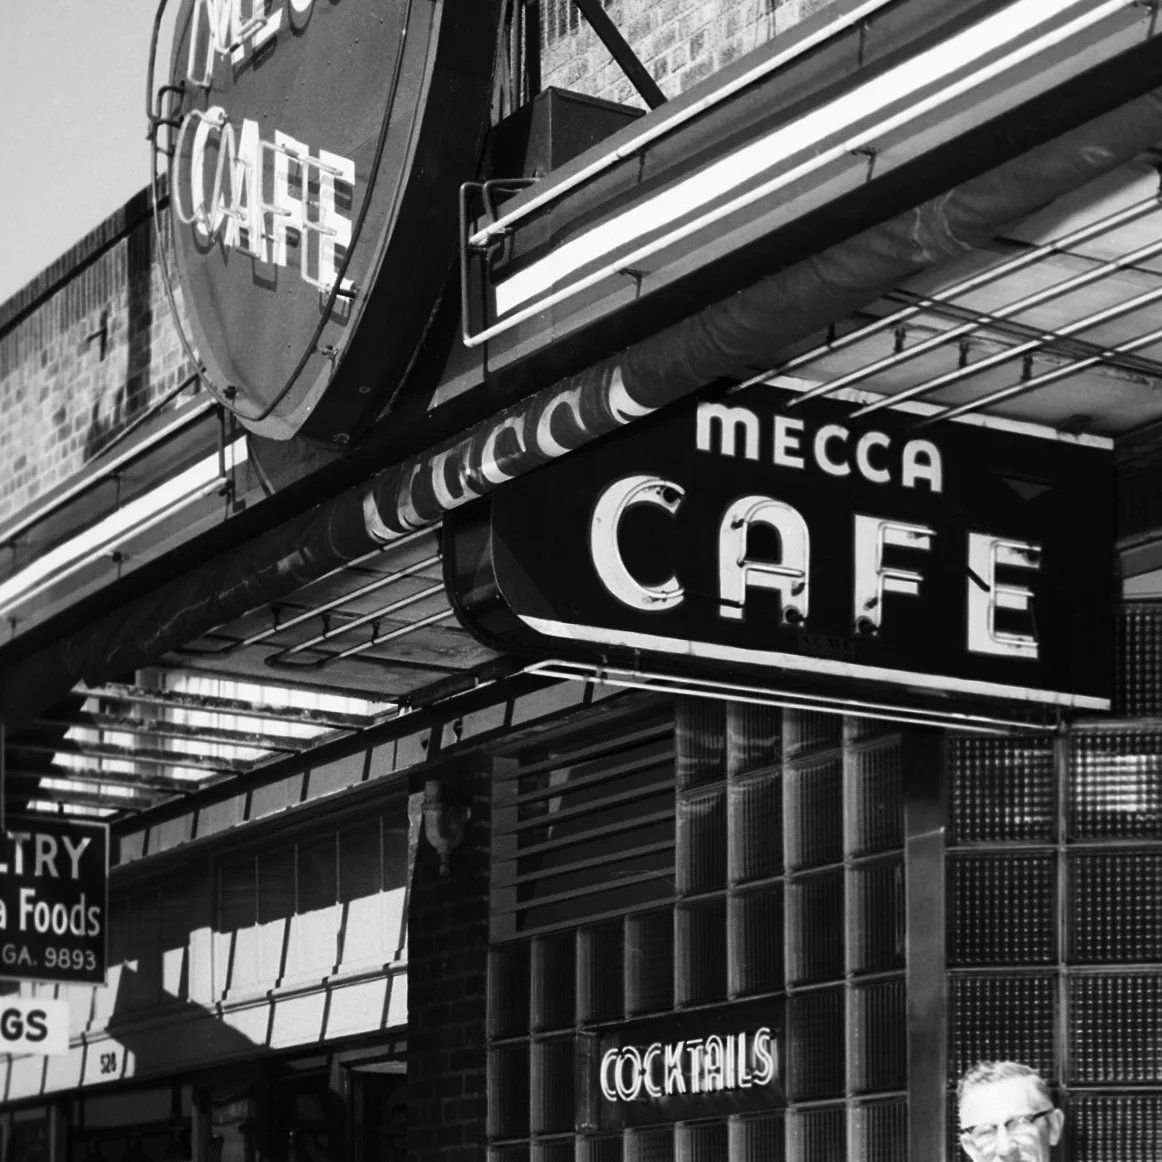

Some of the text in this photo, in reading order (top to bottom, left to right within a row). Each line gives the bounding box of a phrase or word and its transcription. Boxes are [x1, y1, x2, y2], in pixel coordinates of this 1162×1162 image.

[173, 105, 356, 303] CAFE
[696, 402, 942, 492] MECCA
[590, 475, 1042, 658] CAFE
[0, 831, 91, 879] TRY
[19, 887, 100, 937] Foods
[2, 943, 96, 970] GA. 9893
[0, 1007, 48, 1042] GS
[100, 1051, 116, 1074] 528
[601, 1027, 775, 1101] COCKTAILS
